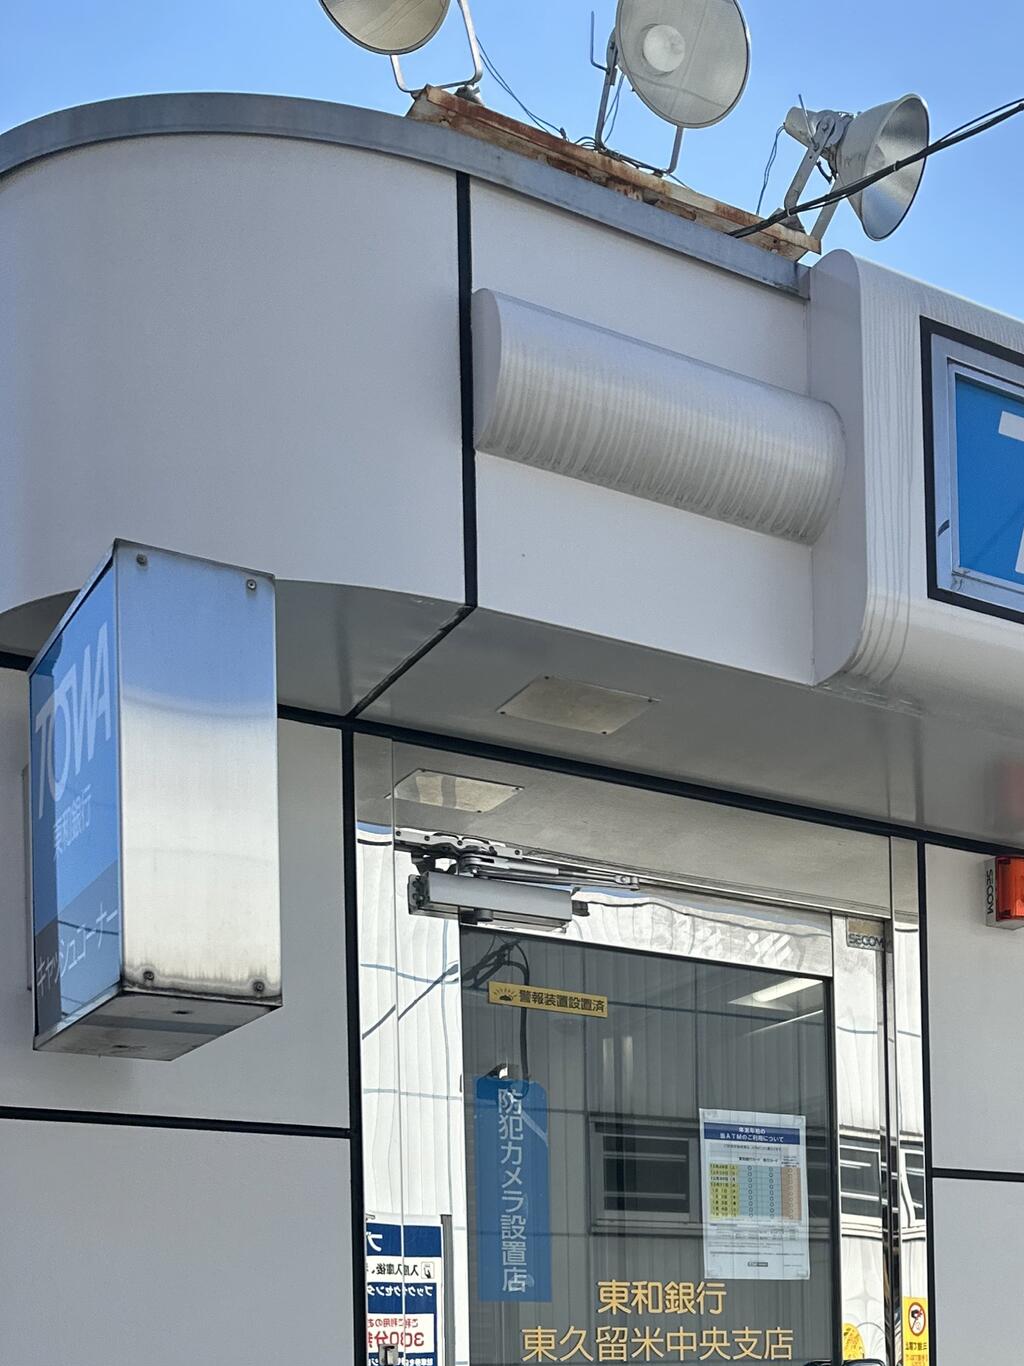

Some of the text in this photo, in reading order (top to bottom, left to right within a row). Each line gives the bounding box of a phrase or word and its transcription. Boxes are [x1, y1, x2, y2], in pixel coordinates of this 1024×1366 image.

[35, 621, 111, 820] TOWA
[53, 784, 92, 862] 東和銀行
[36, 904, 119, 998] キャッシュコーナー
[519, 989, 605, 1013] 警報装置設置済
[496, 1087, 528, 1293] 防犯カメラ設置店
[597, 1280, 728, 1316] 東和銀行
[521, 1325, 794, 1363] 東久留米中央支店
